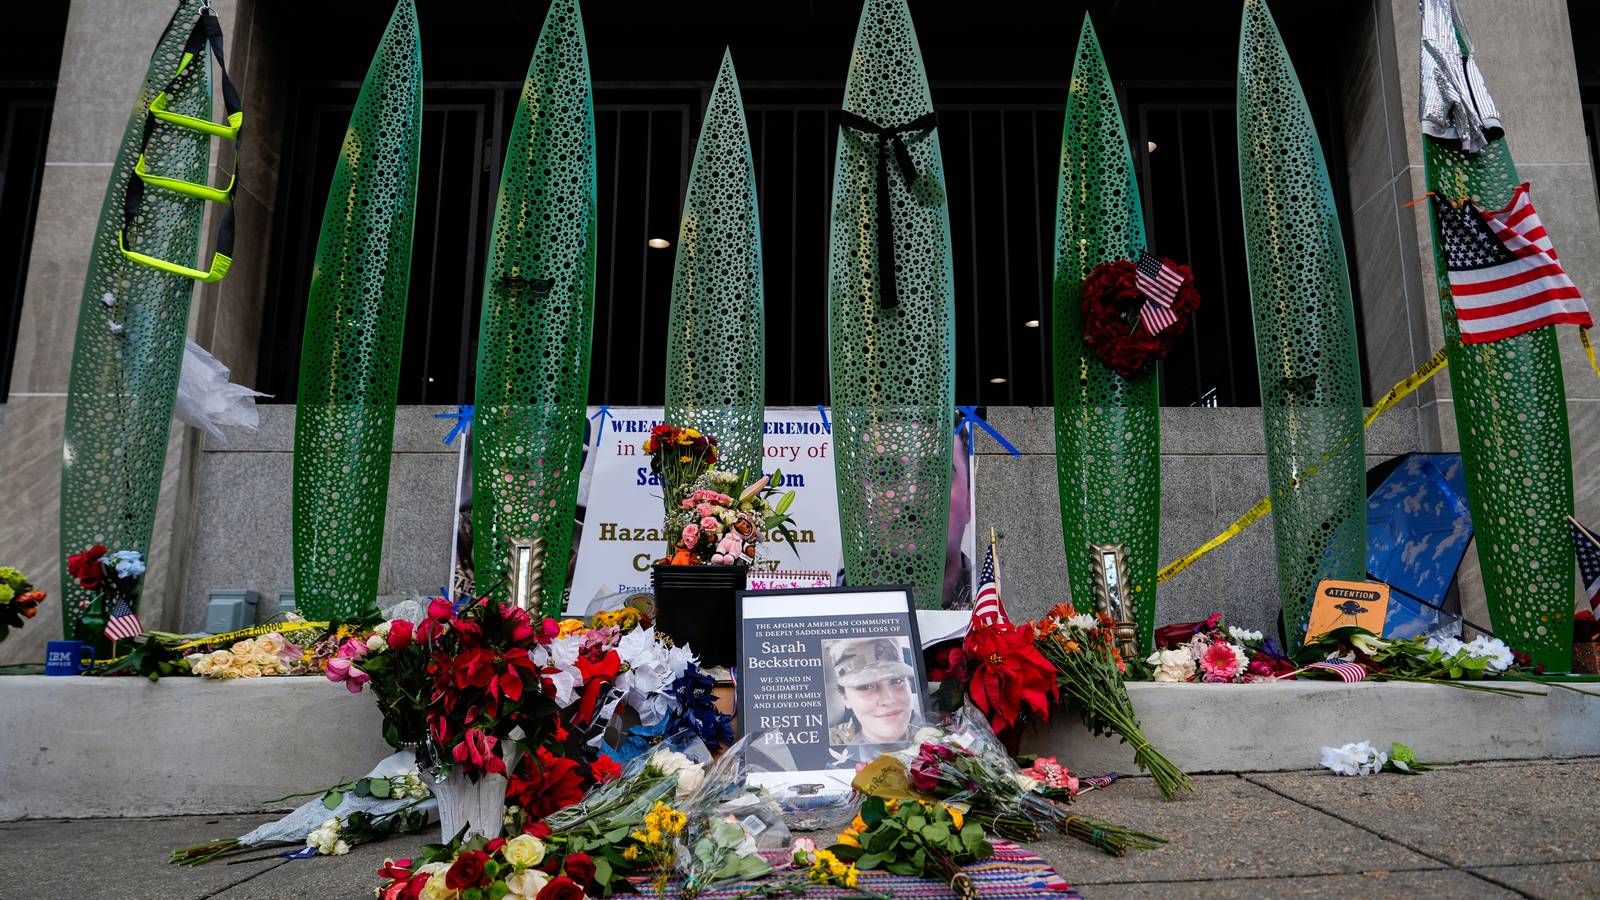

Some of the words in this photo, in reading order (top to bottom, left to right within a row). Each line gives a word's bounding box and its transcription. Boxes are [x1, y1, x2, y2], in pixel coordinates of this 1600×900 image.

[617, 440, 636, 456] in
[807, 442, 828, 458] of
[1328, 589, 1374, 600] ATTENTION
[796, 628, 838, 636] SADDENED
[762, 641, 806, 654] Sarah
[48, 652, 72, 661] IBM
[748, 656, 822, 669] Beckstrom
[760, 716, 801, 728] REST
[805, 715, 823, 727] IN
[765, 731, 820, 745] PEACE
